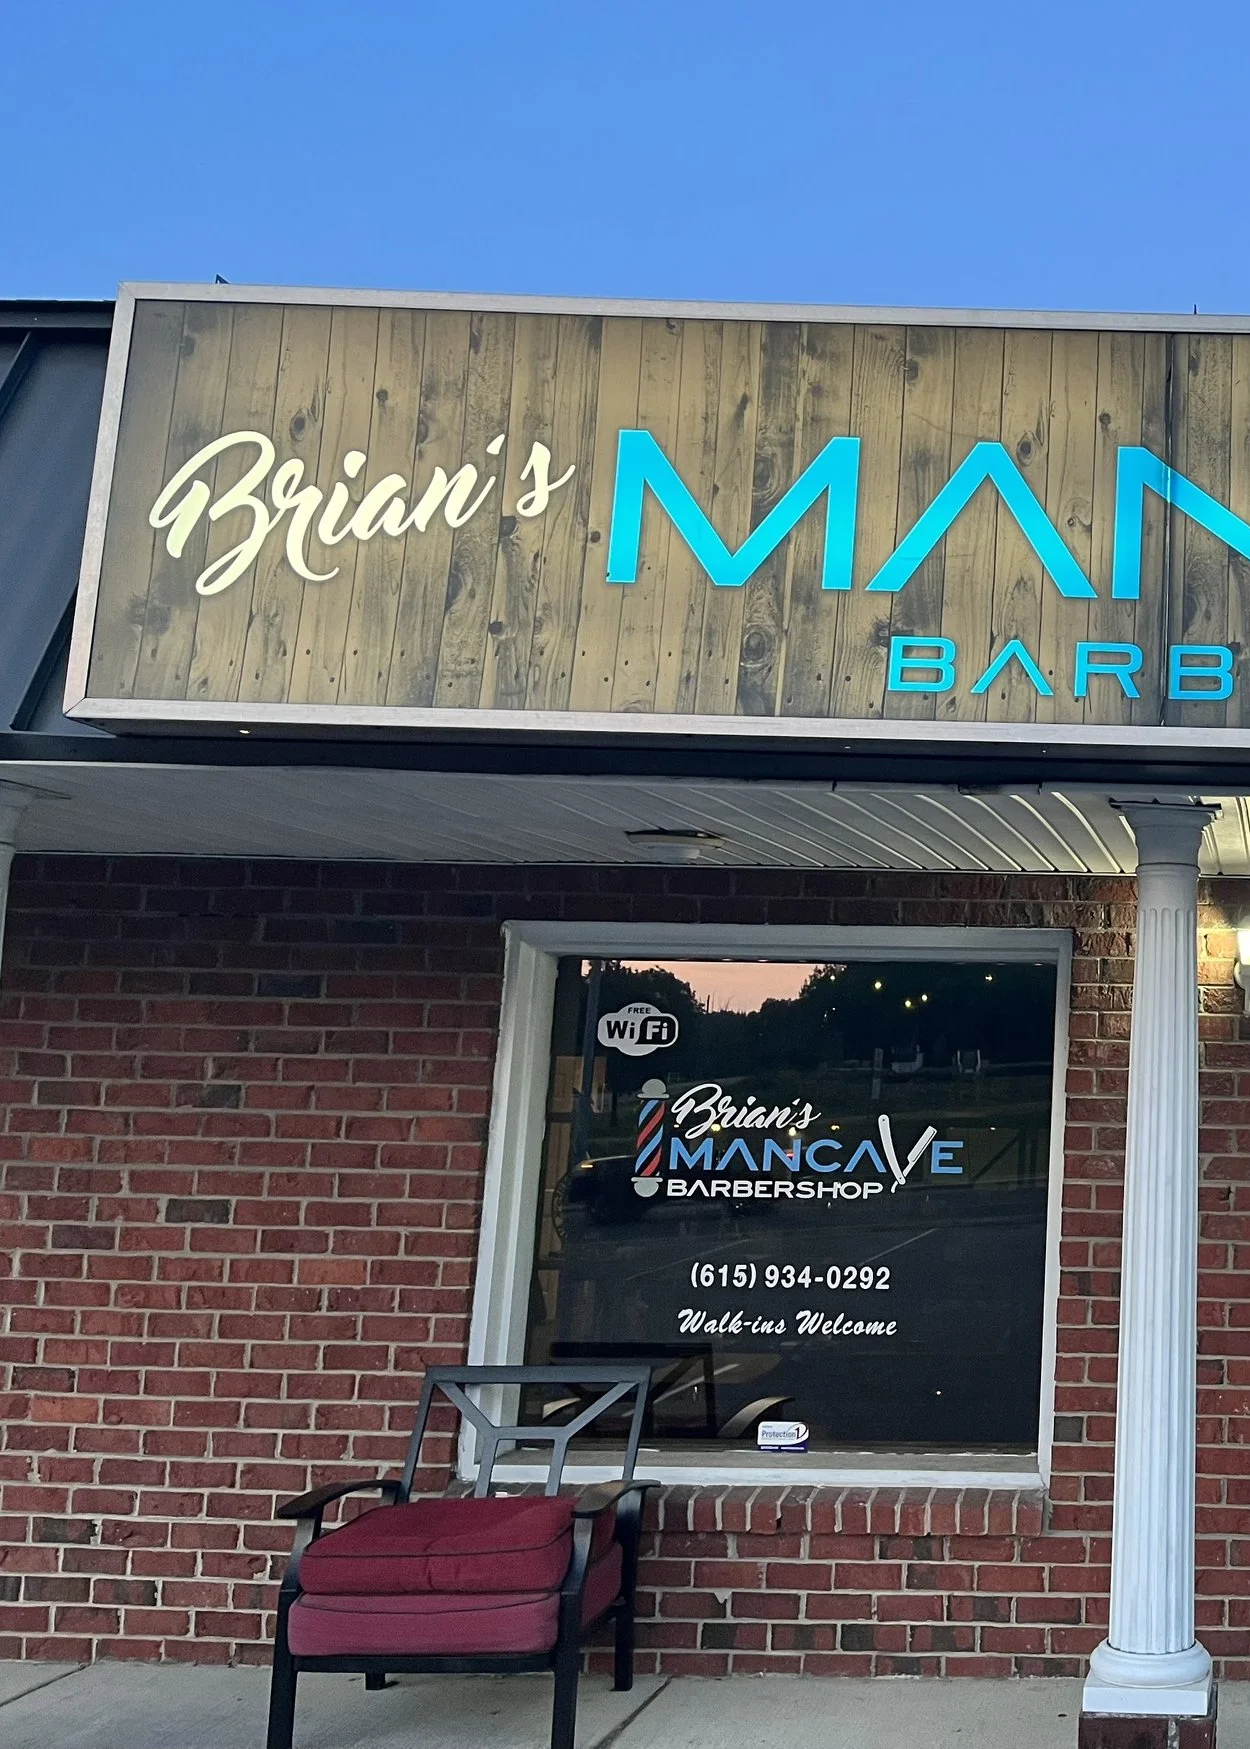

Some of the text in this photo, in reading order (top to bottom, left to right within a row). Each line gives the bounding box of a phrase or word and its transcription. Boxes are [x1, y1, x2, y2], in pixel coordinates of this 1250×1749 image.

[148, 430, 576, 597] Brian's
[627, 1006, 652, 1015] FREE
[671, 1083, 822, 1139] Brian's
[669, 1114, 964, 1193] MANCAVE
[666, 1179, 884, 1201] BARBERSHOP
[690, 1261, 892, 1291] (615) 934-0292
[678, 1308, 899, 1337] Walk-ins Welcome
[761, 1429, 796, 1438] Protection
